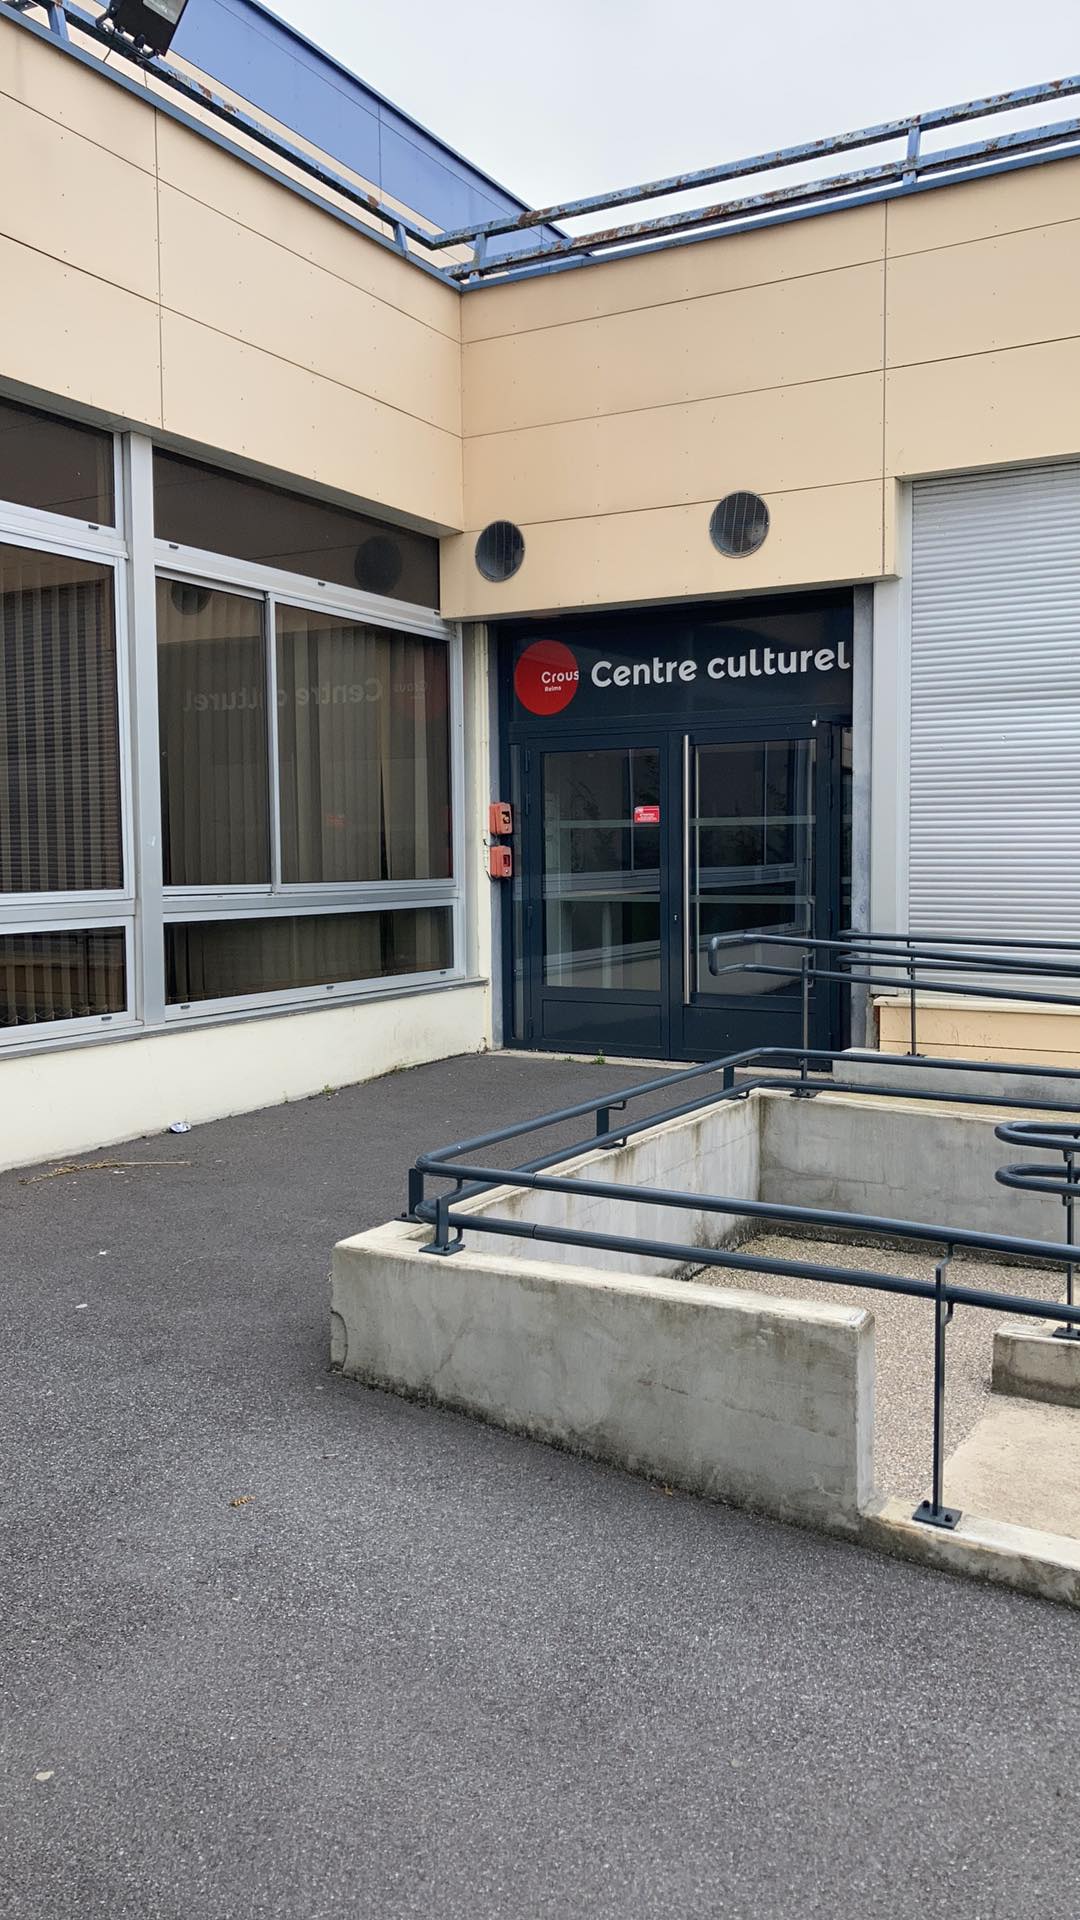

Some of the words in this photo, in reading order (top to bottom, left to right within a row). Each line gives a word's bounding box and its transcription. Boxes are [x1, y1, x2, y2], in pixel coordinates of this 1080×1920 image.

[541, 670, 579, 684] Crous
[591, 656, 697, 687] Centre
[707, 641, 850, 679] culturel
